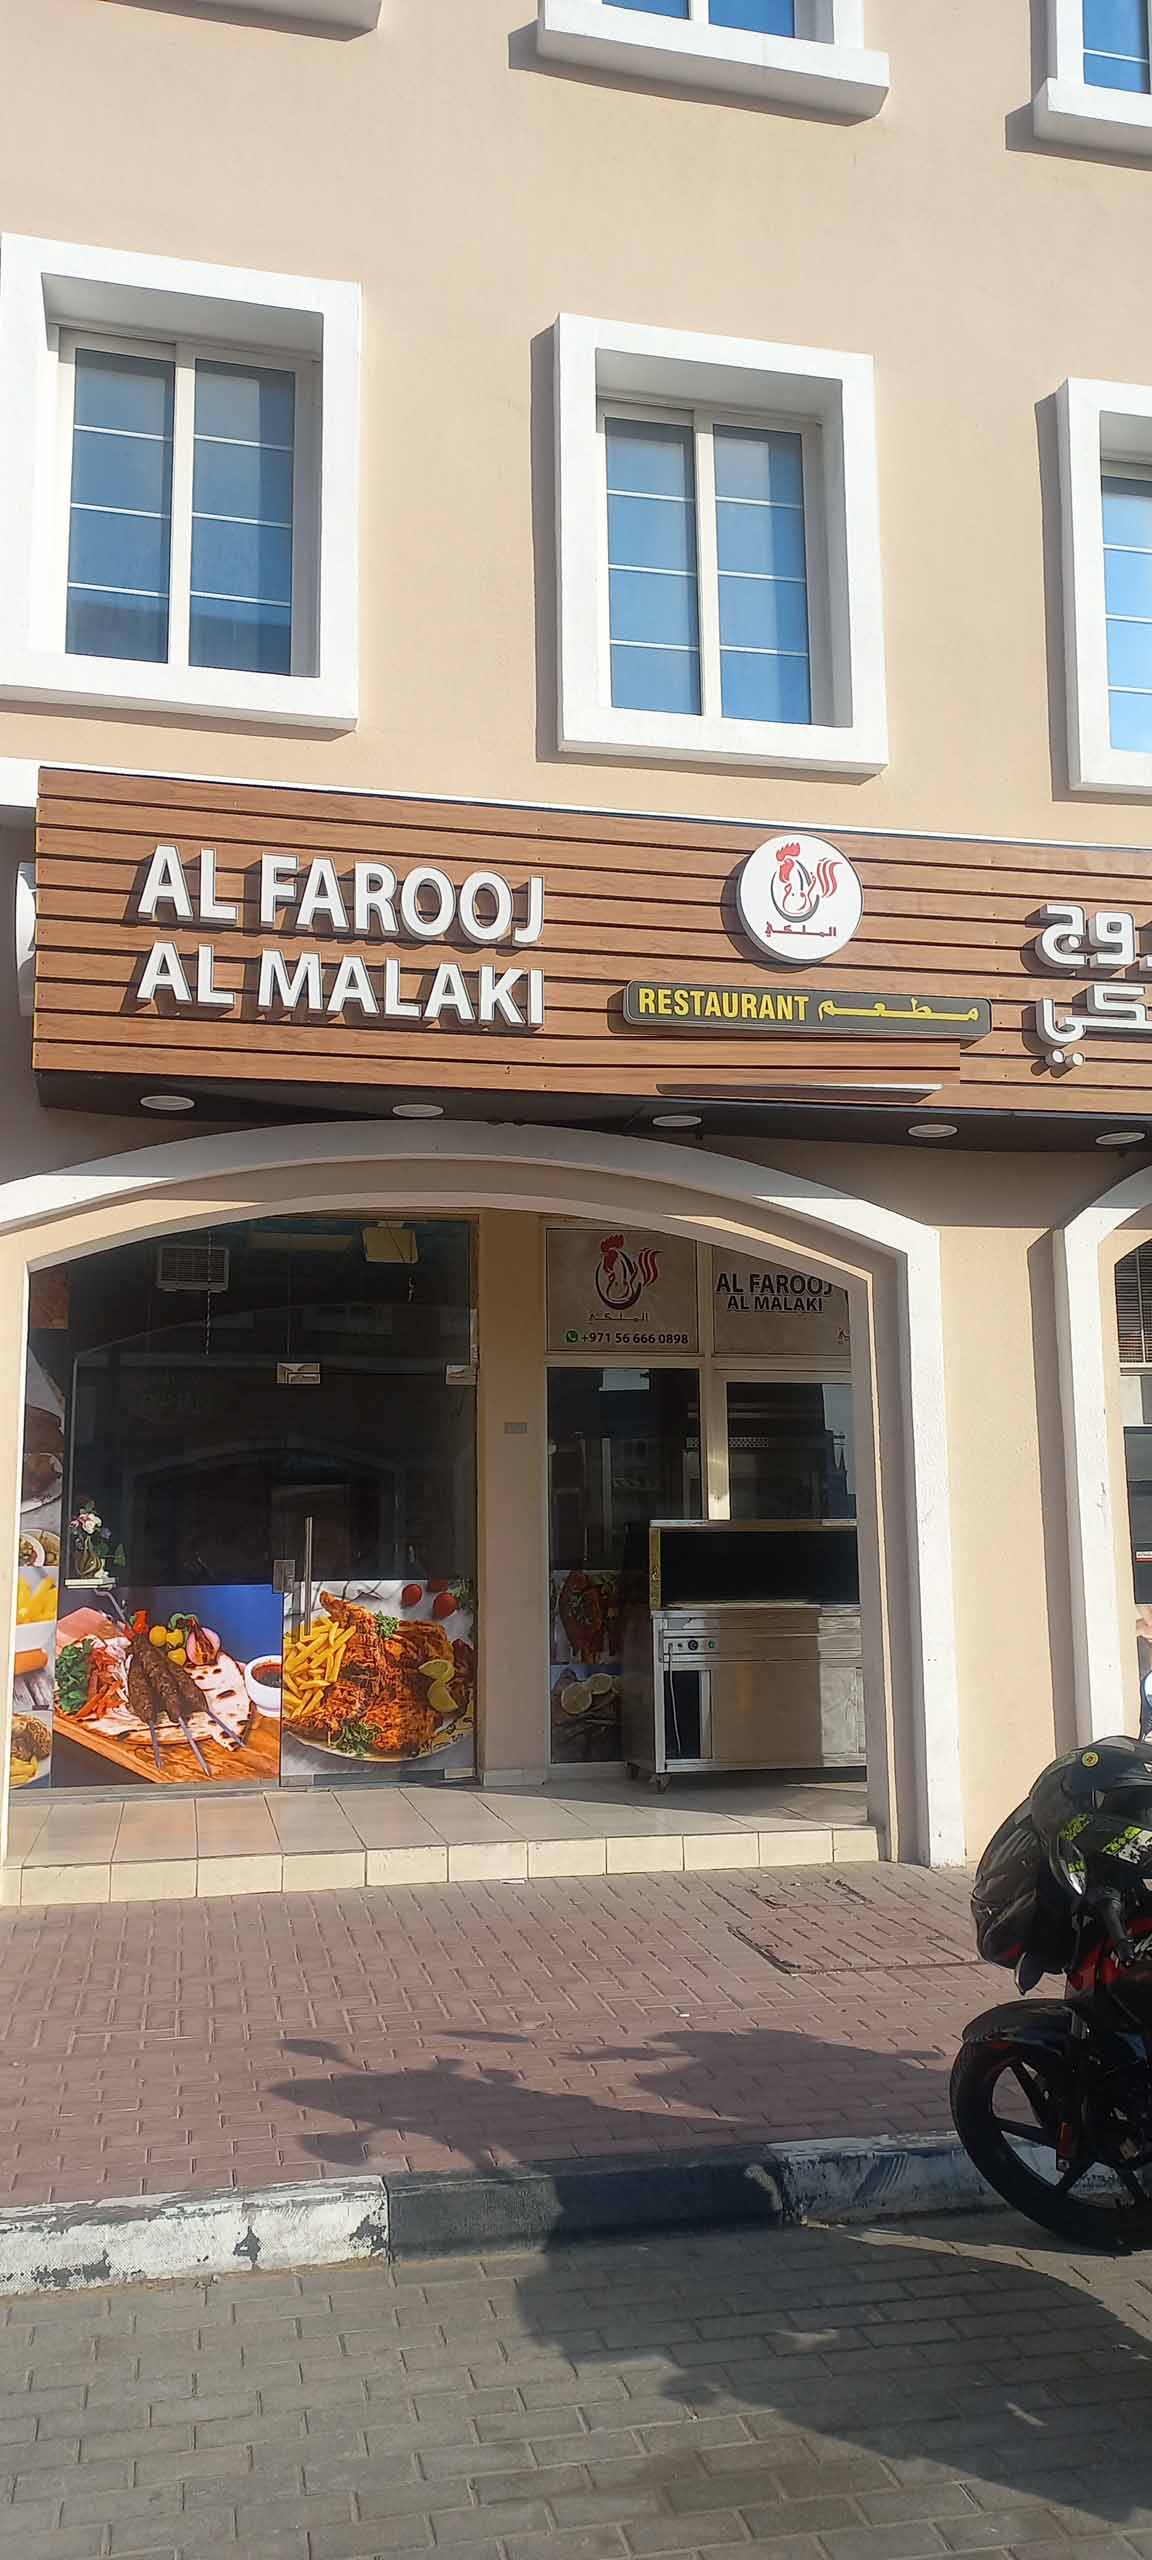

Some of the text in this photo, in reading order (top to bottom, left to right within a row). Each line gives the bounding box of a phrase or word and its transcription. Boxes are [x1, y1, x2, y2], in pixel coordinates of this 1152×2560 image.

[137, 844, 545, 944] AL FAROOJ
[136, 941, 544, 1026] AL MALAKI
[638, 987, 980, 1022] RESTAURANT مطعم
[716, 1272, 744, 1293] AL
[727, 1295, 823, 1312] AL MALAKI
[581, 1332, 689, 1345] +971 56 666 0898
